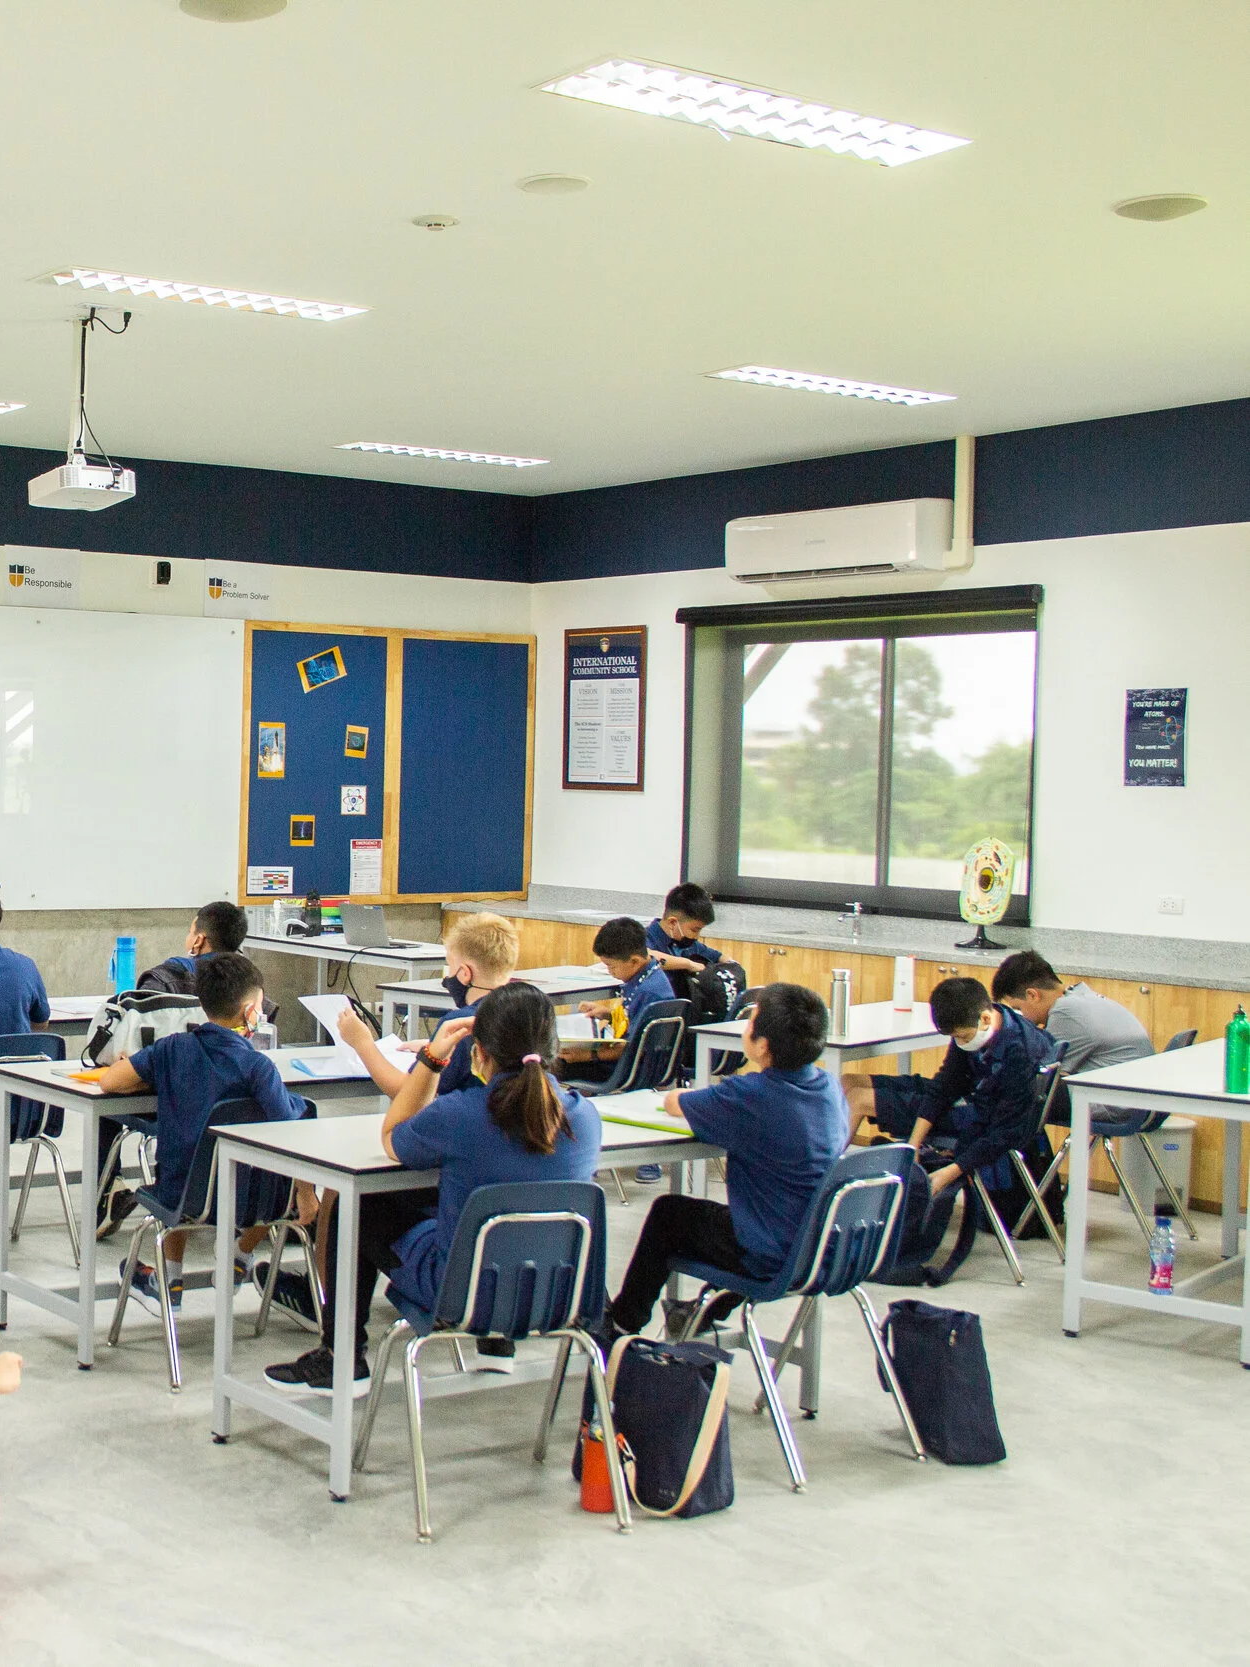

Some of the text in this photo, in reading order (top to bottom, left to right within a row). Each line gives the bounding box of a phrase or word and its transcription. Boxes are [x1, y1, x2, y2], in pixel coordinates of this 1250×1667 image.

[24, 565, 36, 574] Be
[24, 577, 72, 588] Responsible
[222, 580, 232, 588] Be
[222, 590, 270, 600] Problem Solver
[573, 656, 637, 667] INTERNATIONAL
[573, 666, 637, 675] COMMUNITY SCHOOL
[1129, 759, 1177, 768] YOU MATTER!
